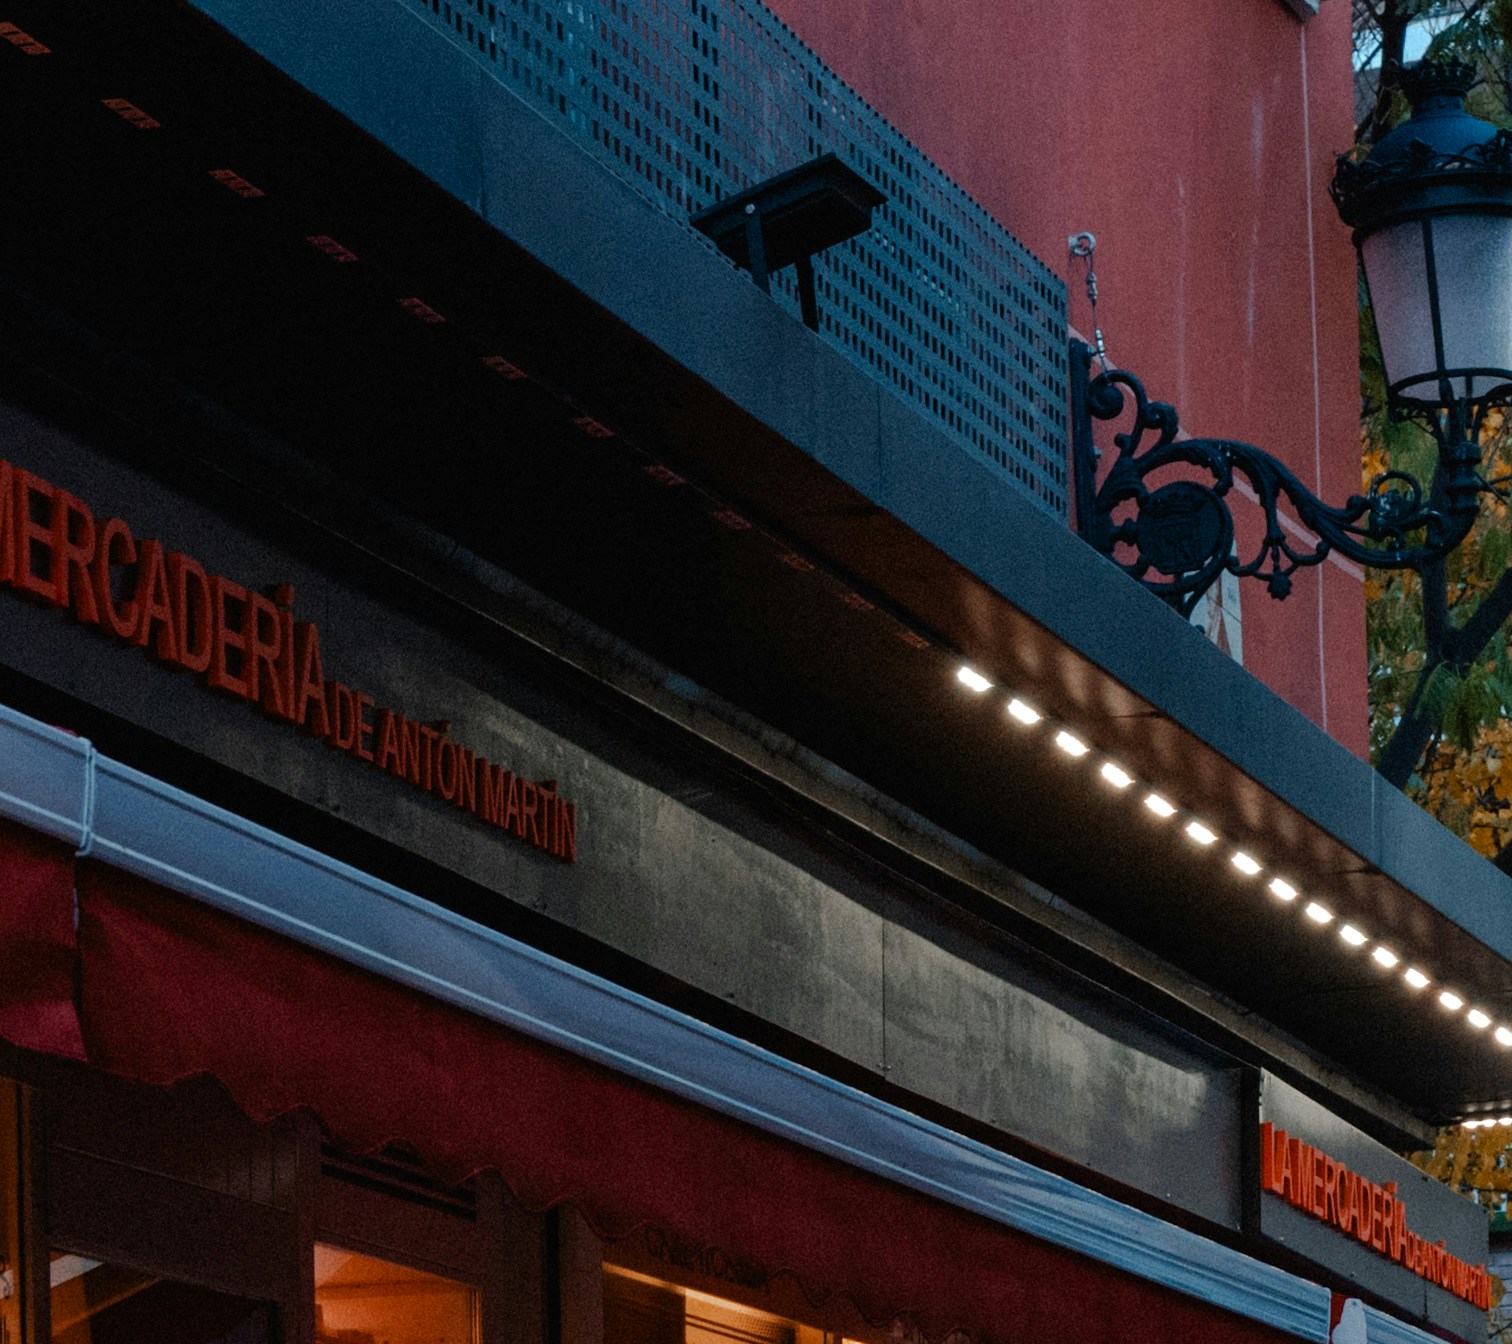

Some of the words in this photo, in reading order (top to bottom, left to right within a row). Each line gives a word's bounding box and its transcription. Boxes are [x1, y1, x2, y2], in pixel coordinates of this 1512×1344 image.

[328, 680, 376, 763] DE
[377, 707, 479, 813] ANTÓN
[479, 758, 577, 863] MARTÍN
[1260, 1121, 1294, 1206] LA
[1289, 1137, 1407, 1263] MERCADERÍA
